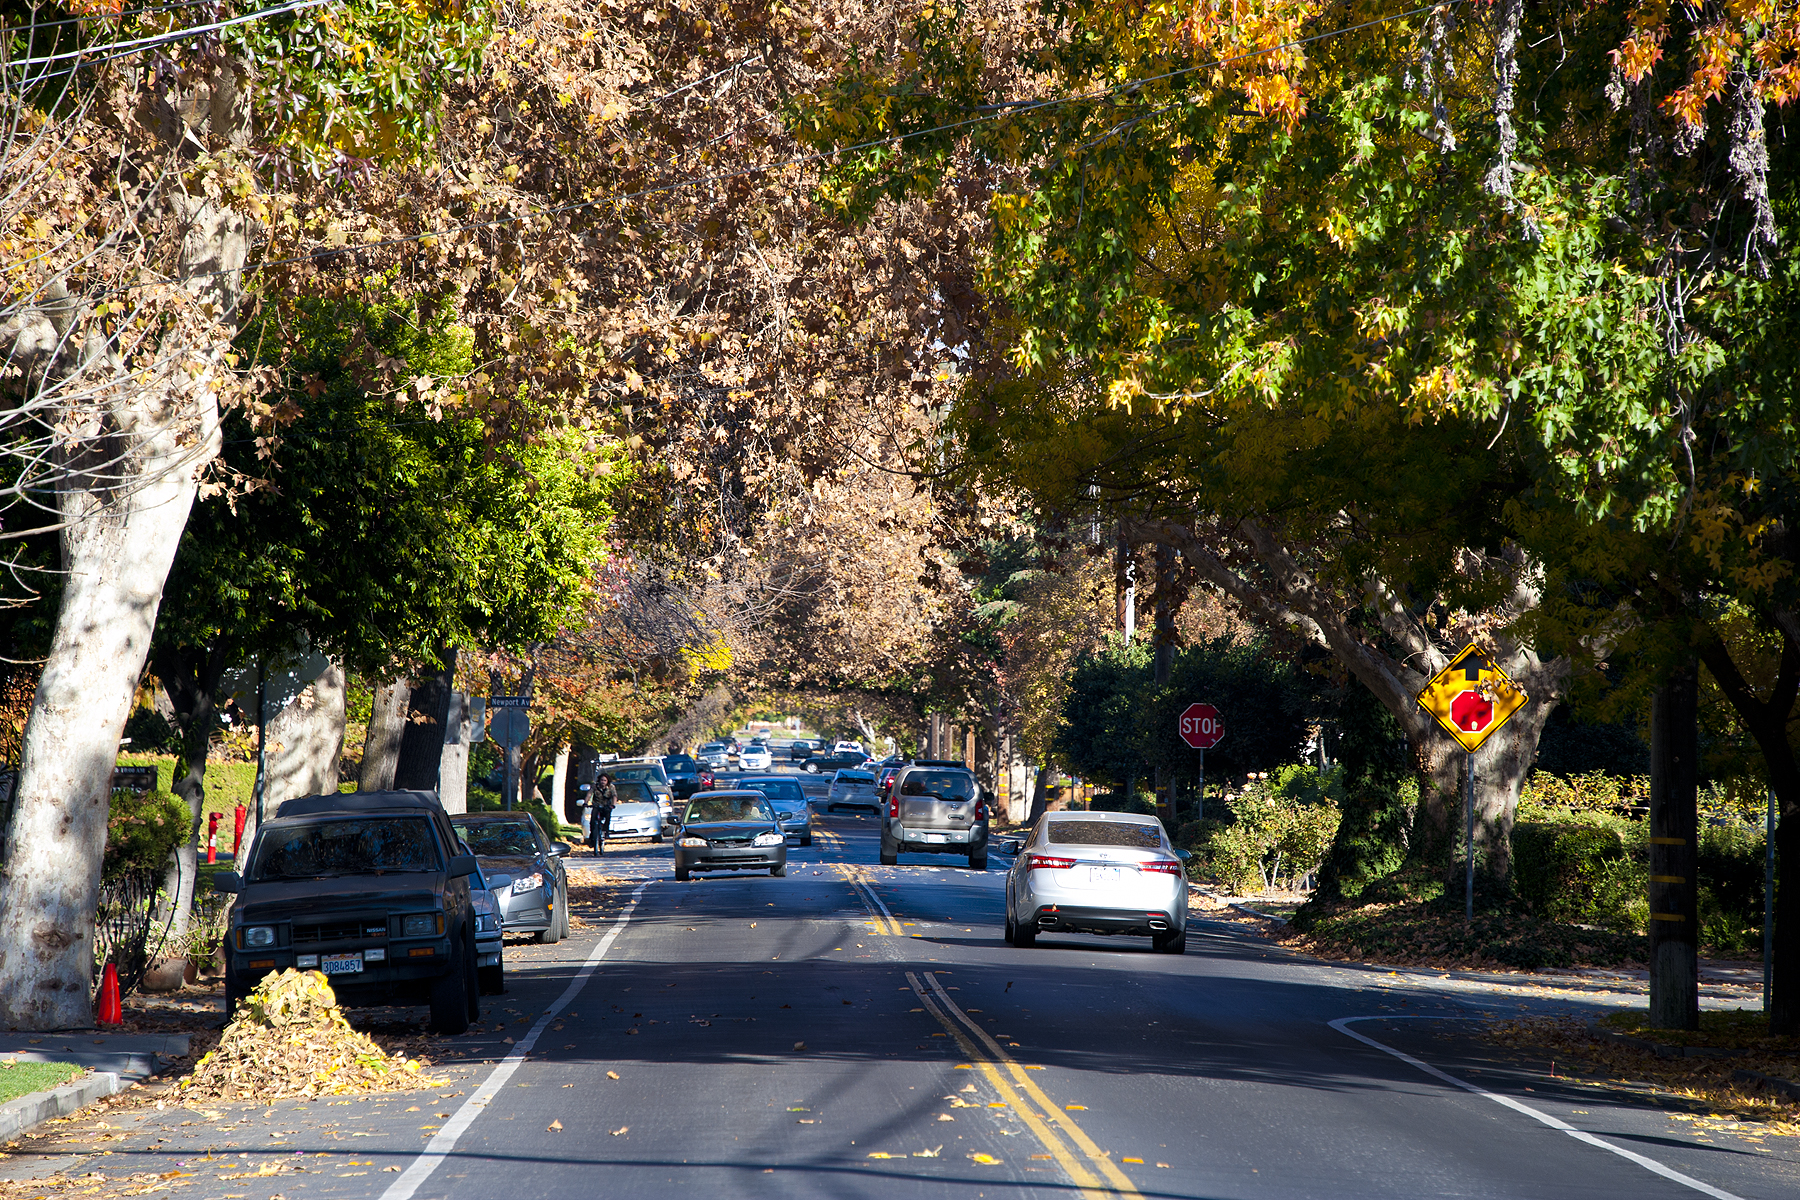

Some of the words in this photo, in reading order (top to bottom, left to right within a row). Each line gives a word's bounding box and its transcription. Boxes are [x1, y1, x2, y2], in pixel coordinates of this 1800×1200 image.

[491, 698, 519, 707] Newport
[520, 698, 530, 706] Av
[323, 959, 361, 972] 3D84857
